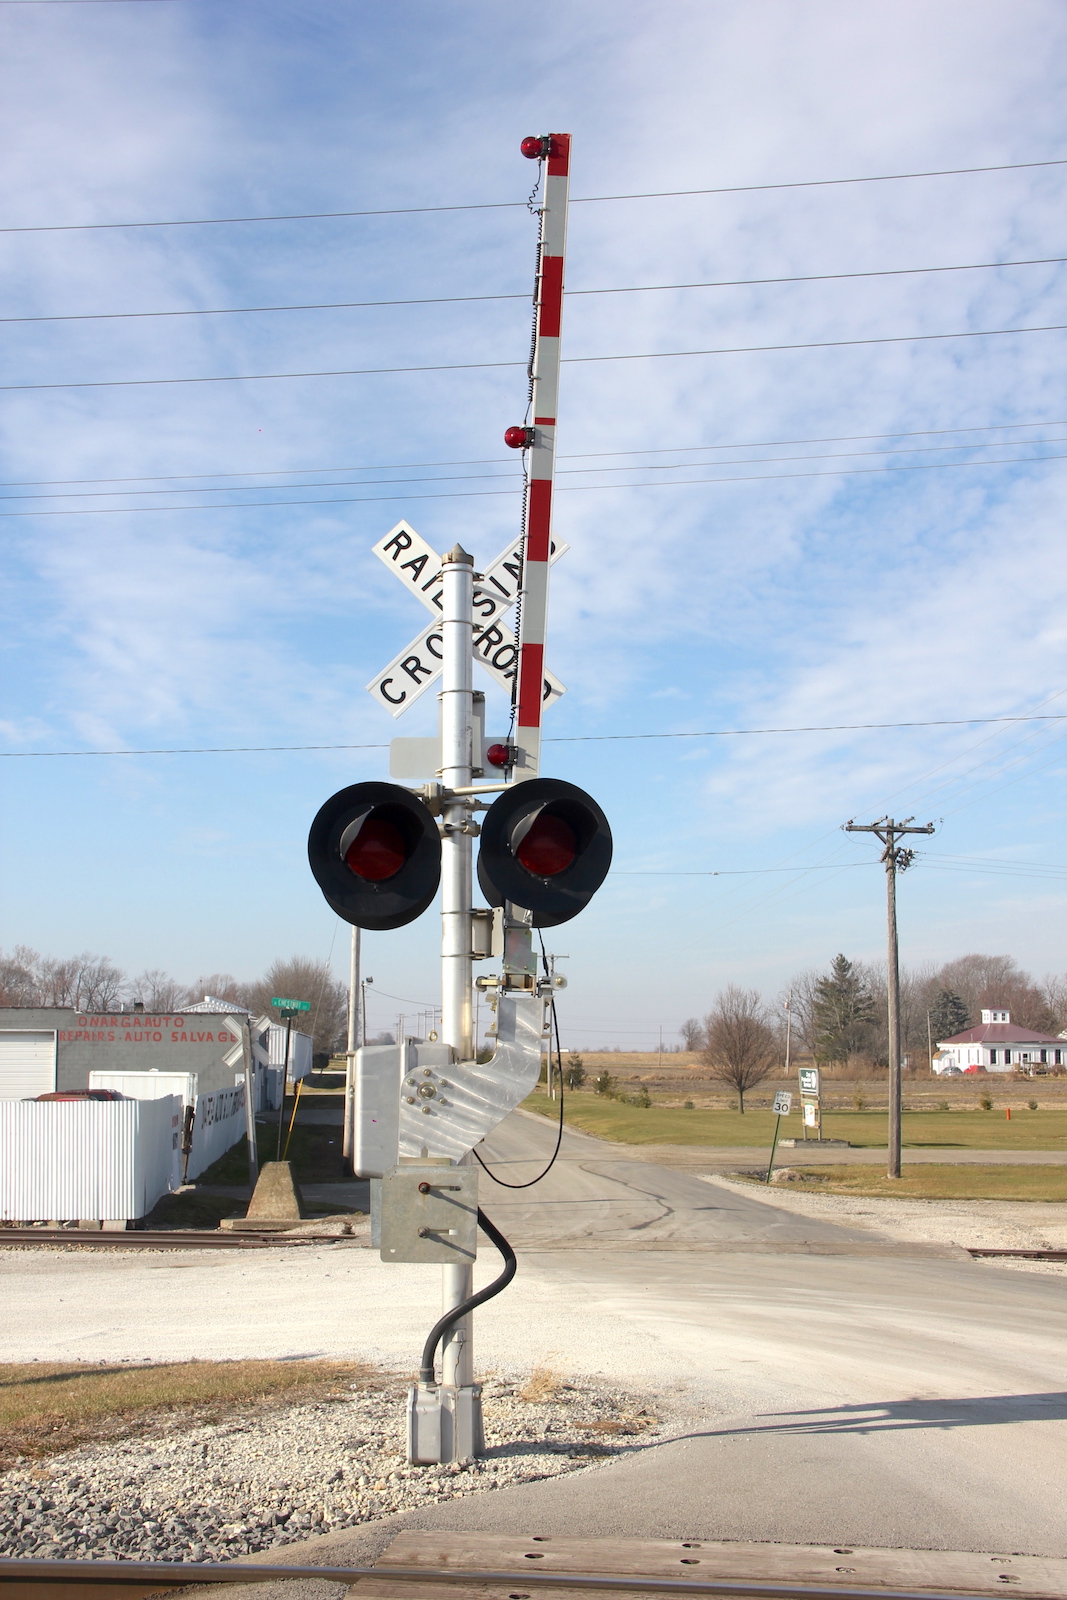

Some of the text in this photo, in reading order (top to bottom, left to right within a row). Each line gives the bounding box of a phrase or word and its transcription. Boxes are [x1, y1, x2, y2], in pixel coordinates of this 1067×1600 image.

[77, 1016, 185, 1028] ONARGA AUTO
[59, 1030, 237, 1042] REPAIRS AUTO SALVAGE
[774, 1102, 789, 1112] 30
